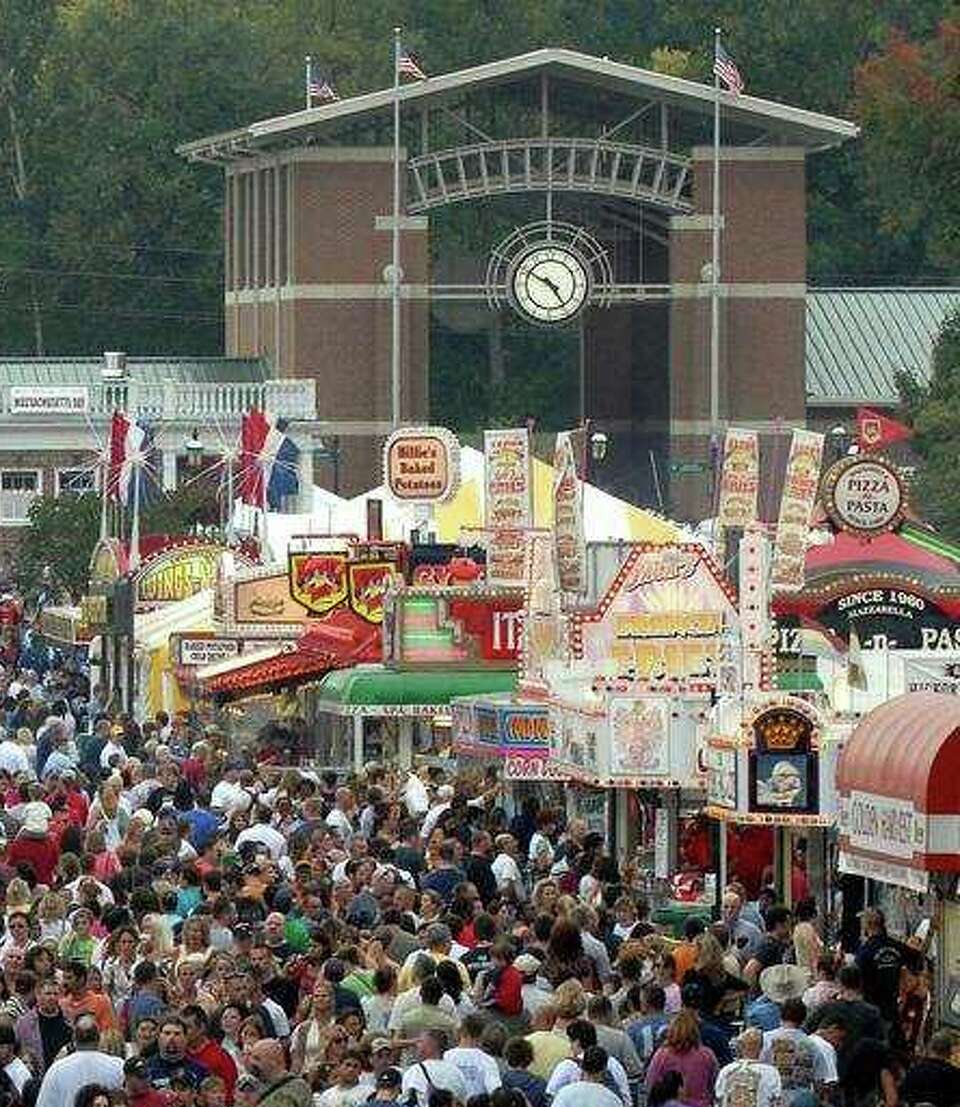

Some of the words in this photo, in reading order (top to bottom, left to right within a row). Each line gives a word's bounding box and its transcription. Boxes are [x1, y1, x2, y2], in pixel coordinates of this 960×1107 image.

[847, 479, 890, 494] PIZZA
[847, 499, 889, 513] PASTA
[838, 589, 884, 611] SINCE
